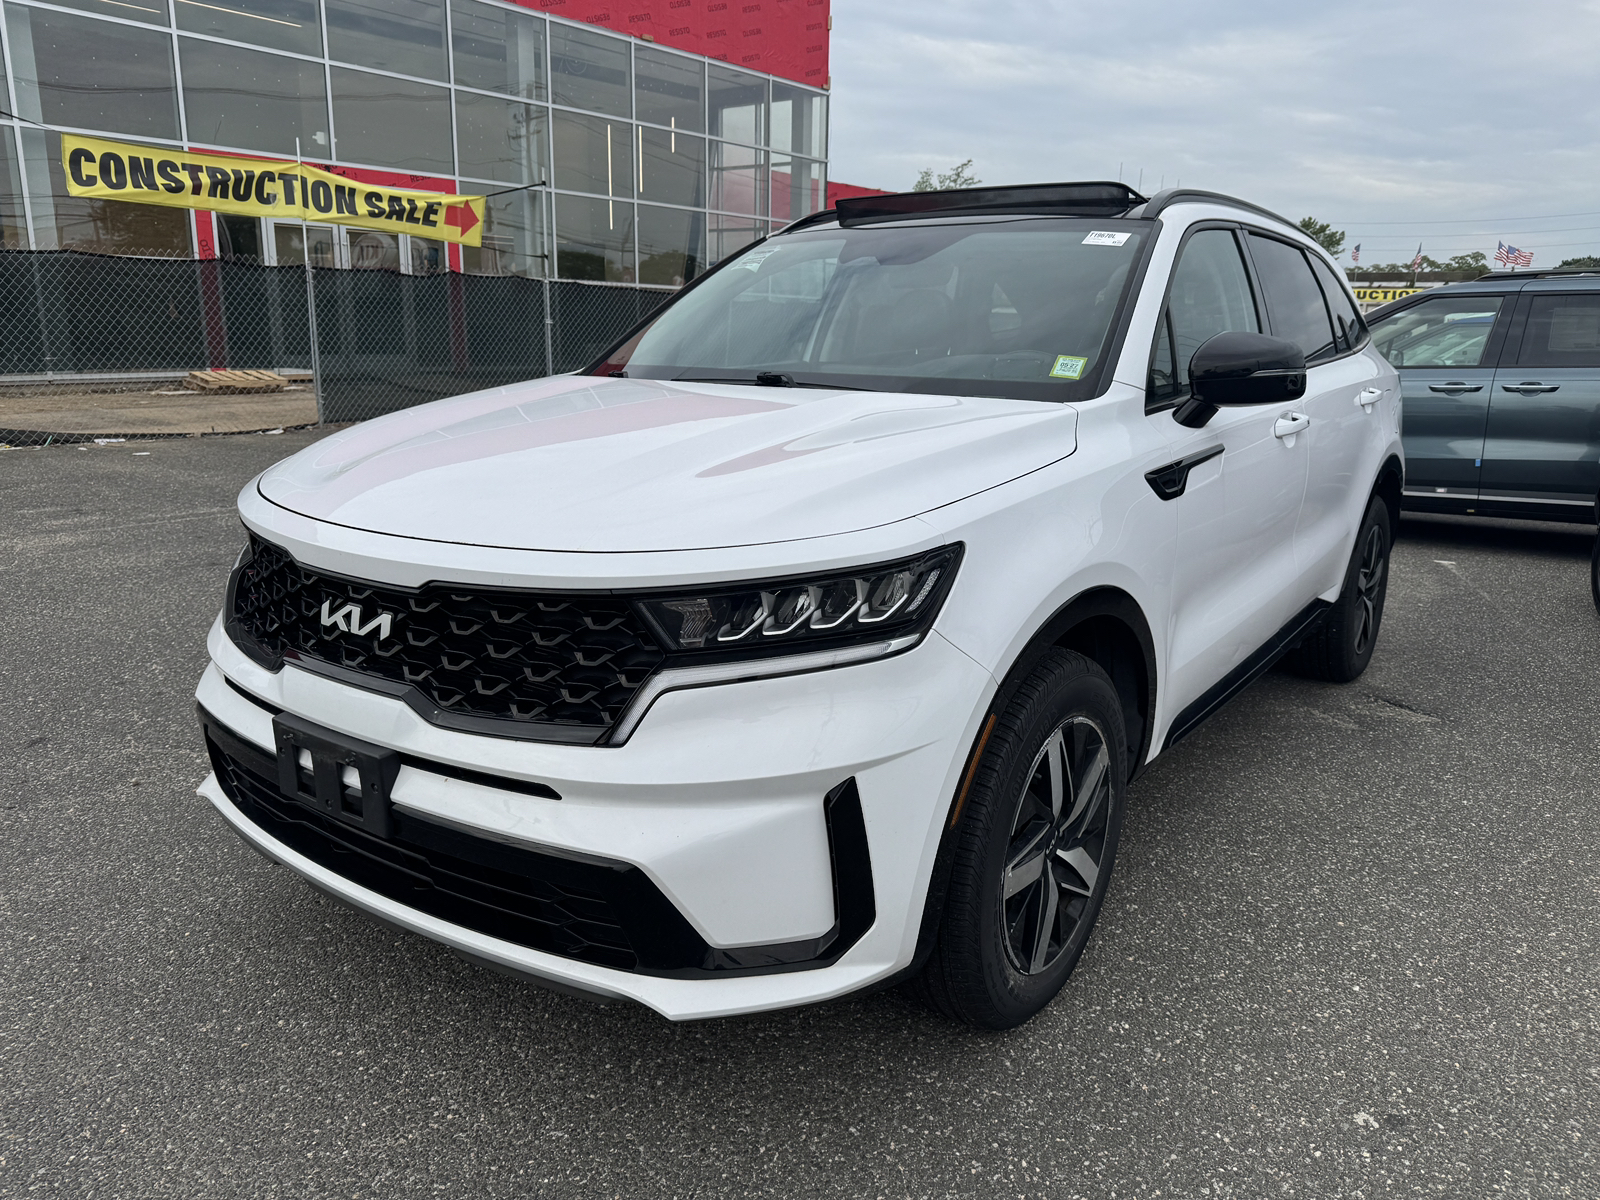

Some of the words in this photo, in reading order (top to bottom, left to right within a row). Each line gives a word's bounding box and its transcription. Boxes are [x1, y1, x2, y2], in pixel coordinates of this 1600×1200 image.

[68, 148, 360, 216] CONSTRUCTION
[367, 191, 443, 228] SALE
[1353, 290, 1418, 300] UCTIO
[320, 599, 392, 641] KIA
